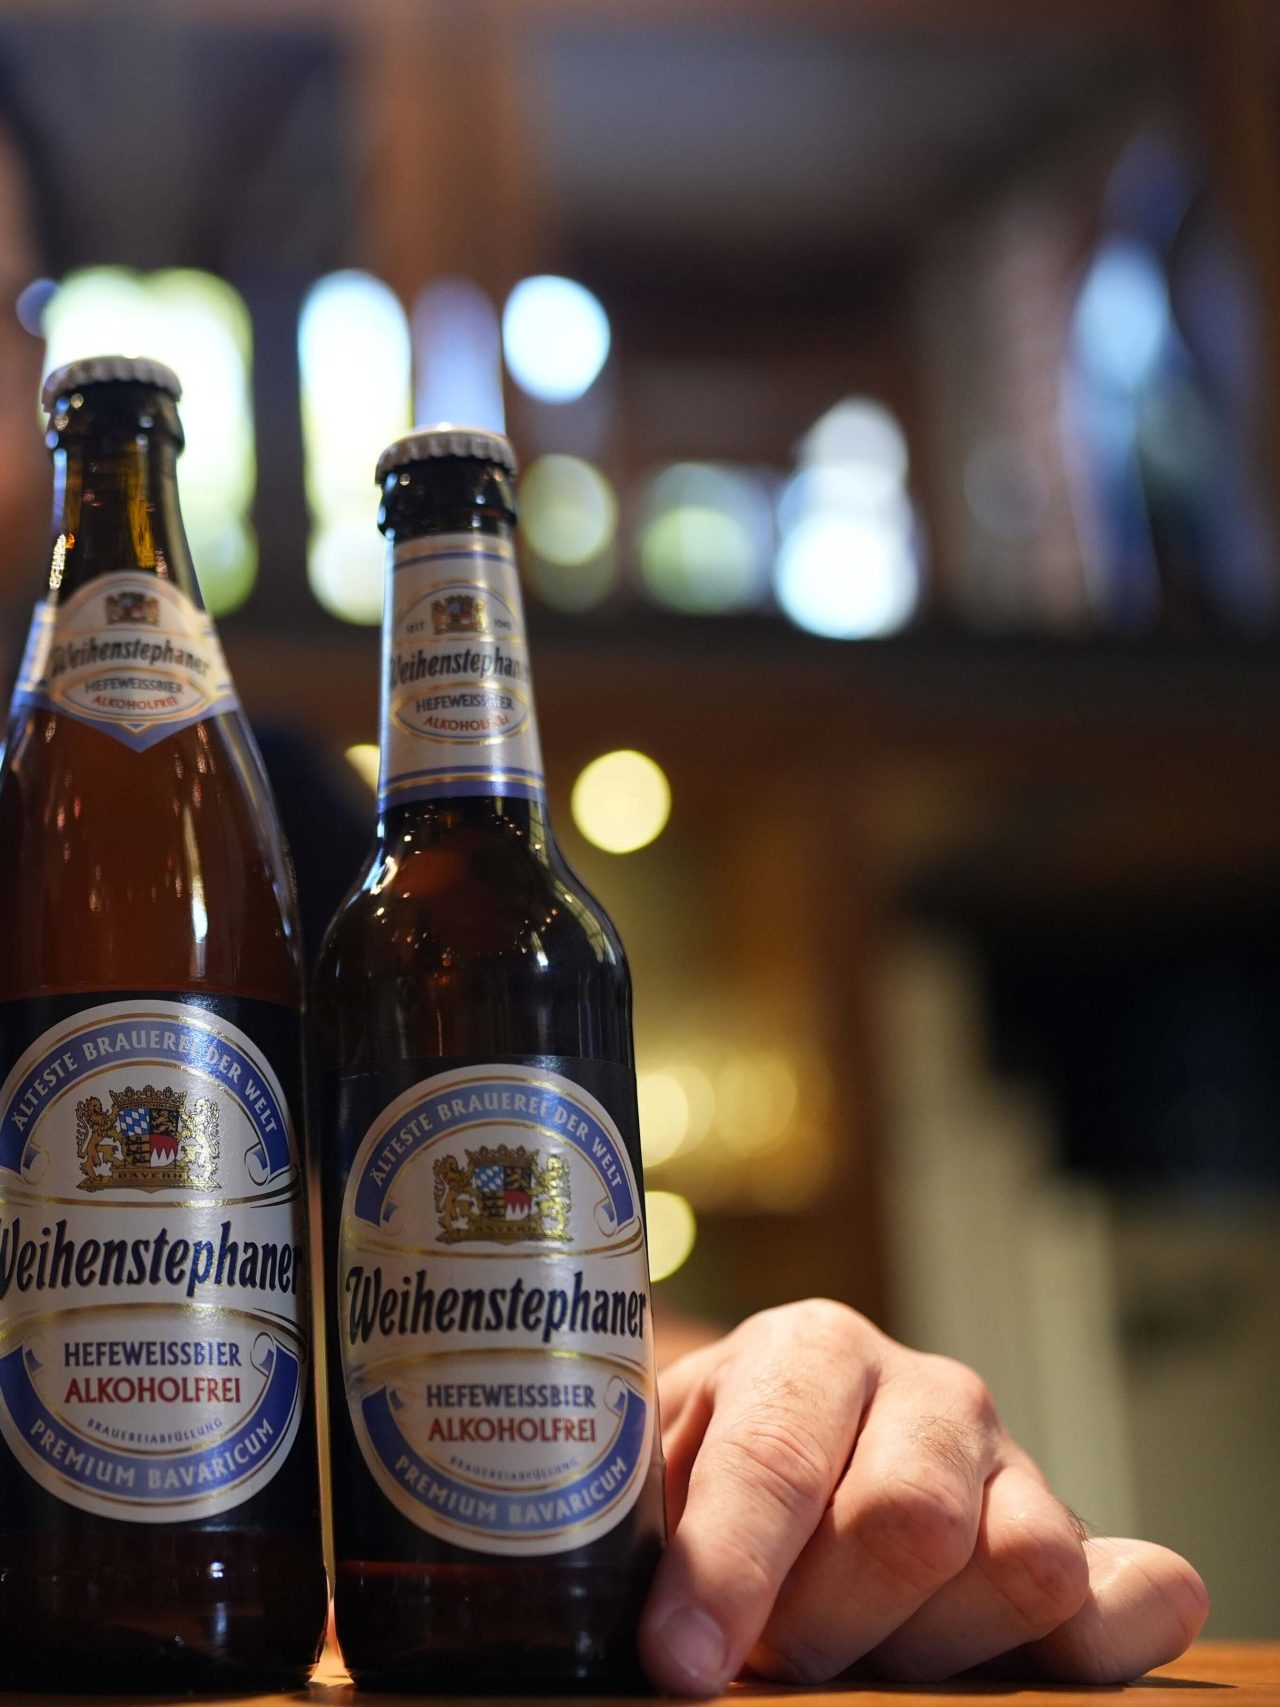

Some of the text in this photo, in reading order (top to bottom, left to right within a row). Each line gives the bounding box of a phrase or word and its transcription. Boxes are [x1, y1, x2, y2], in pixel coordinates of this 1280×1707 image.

[85, 677, 183, 694] HEFEWEISSBIER
[95, 695, 177, 711] ALKOHOLFREI
[10, 1029, 278, 1133] ÄLTESTE BRAUEREI DER WELT
[370, 1091, 623, 1187] ÄLTESTE BRAUEREI DER WELT
[345, 1266, 646, 1345] Weihenstephaner
[64, 1341, 241, 1367] HEFEWEISSBIER
[64, 1376, 241, 1403] ALKOHOLFREI
[426, 1384, 596, 1408] HEFEWEISSBIER
[86, 1417, 222, 1444] BRAUEREIABFÜLLUNG
[427, 1416, 596, 1443] ALKOHOLFREI
[30, 1418, 274, 1489] PREMIUM BAVARICUM
[394, 1455, 627, 1525] PREMIUM BAVARICUM
